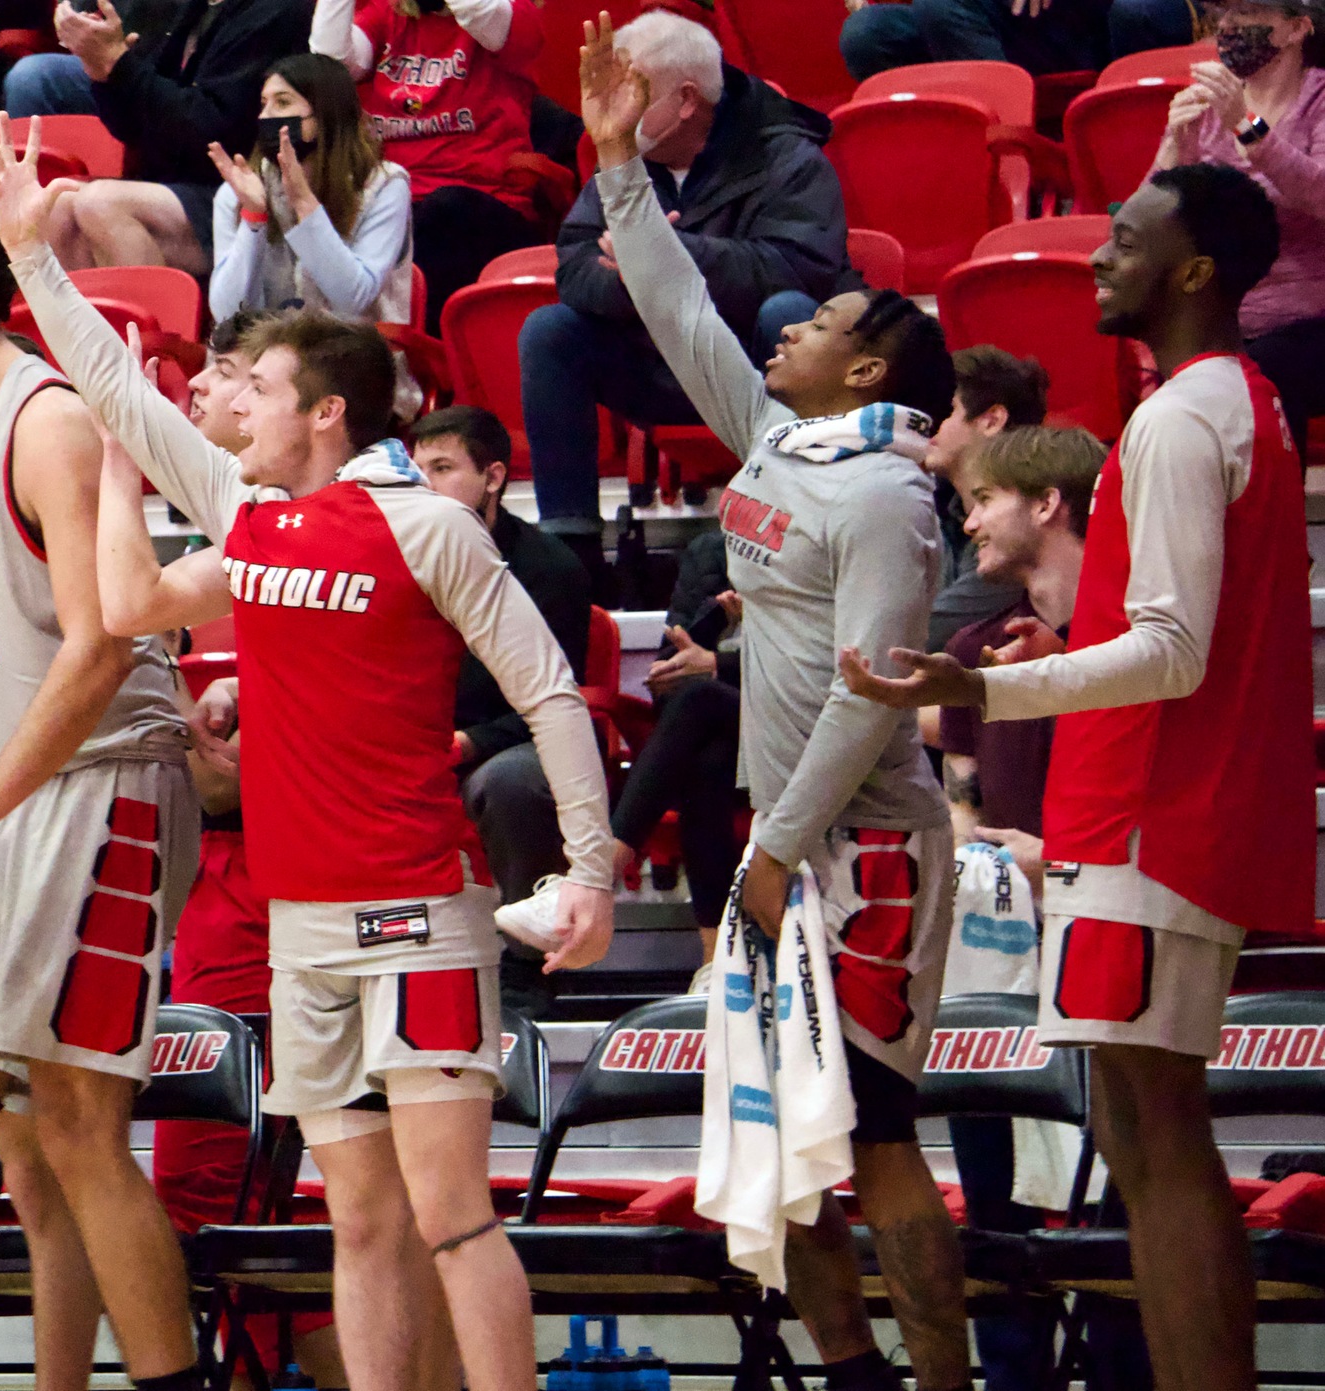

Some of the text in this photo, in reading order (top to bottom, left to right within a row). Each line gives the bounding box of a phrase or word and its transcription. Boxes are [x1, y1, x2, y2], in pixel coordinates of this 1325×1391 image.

[150, 1031, 231, 1076] OLIC
[599, 1029, 707, 1073] CATH
[923, 1026, 1054, 1073] THOLIC
